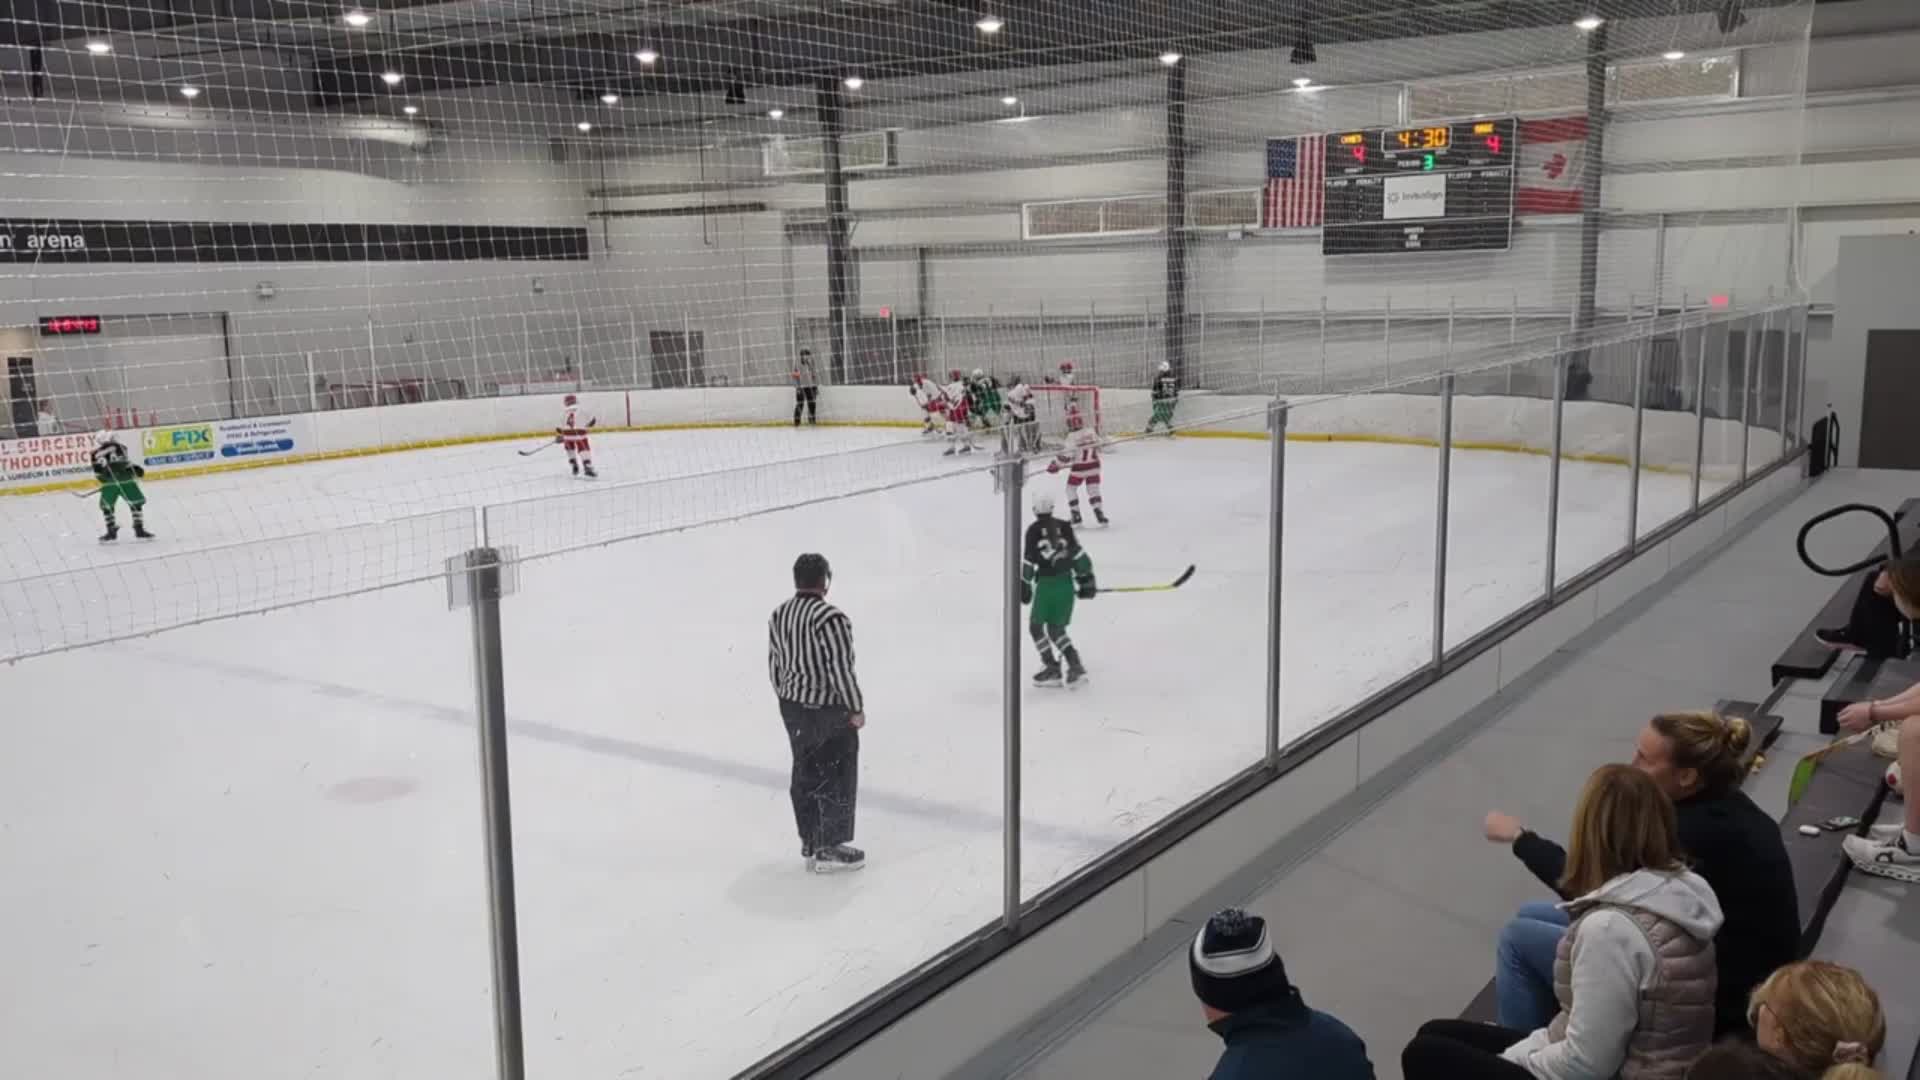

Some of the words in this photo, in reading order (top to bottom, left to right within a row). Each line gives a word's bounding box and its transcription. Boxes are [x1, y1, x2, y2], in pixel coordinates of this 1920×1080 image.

[1398, 127, 1447, 149] 4:30
[1486, 134, 1501, 155] 4
[1352, 145, 1366, 164] 4
[1423, 153, 1435, 171] 3
[27, 234, 84, 249] arena
[17, 434, 97, 453] SURGERY
[172, 429, 209, 446] FIX
